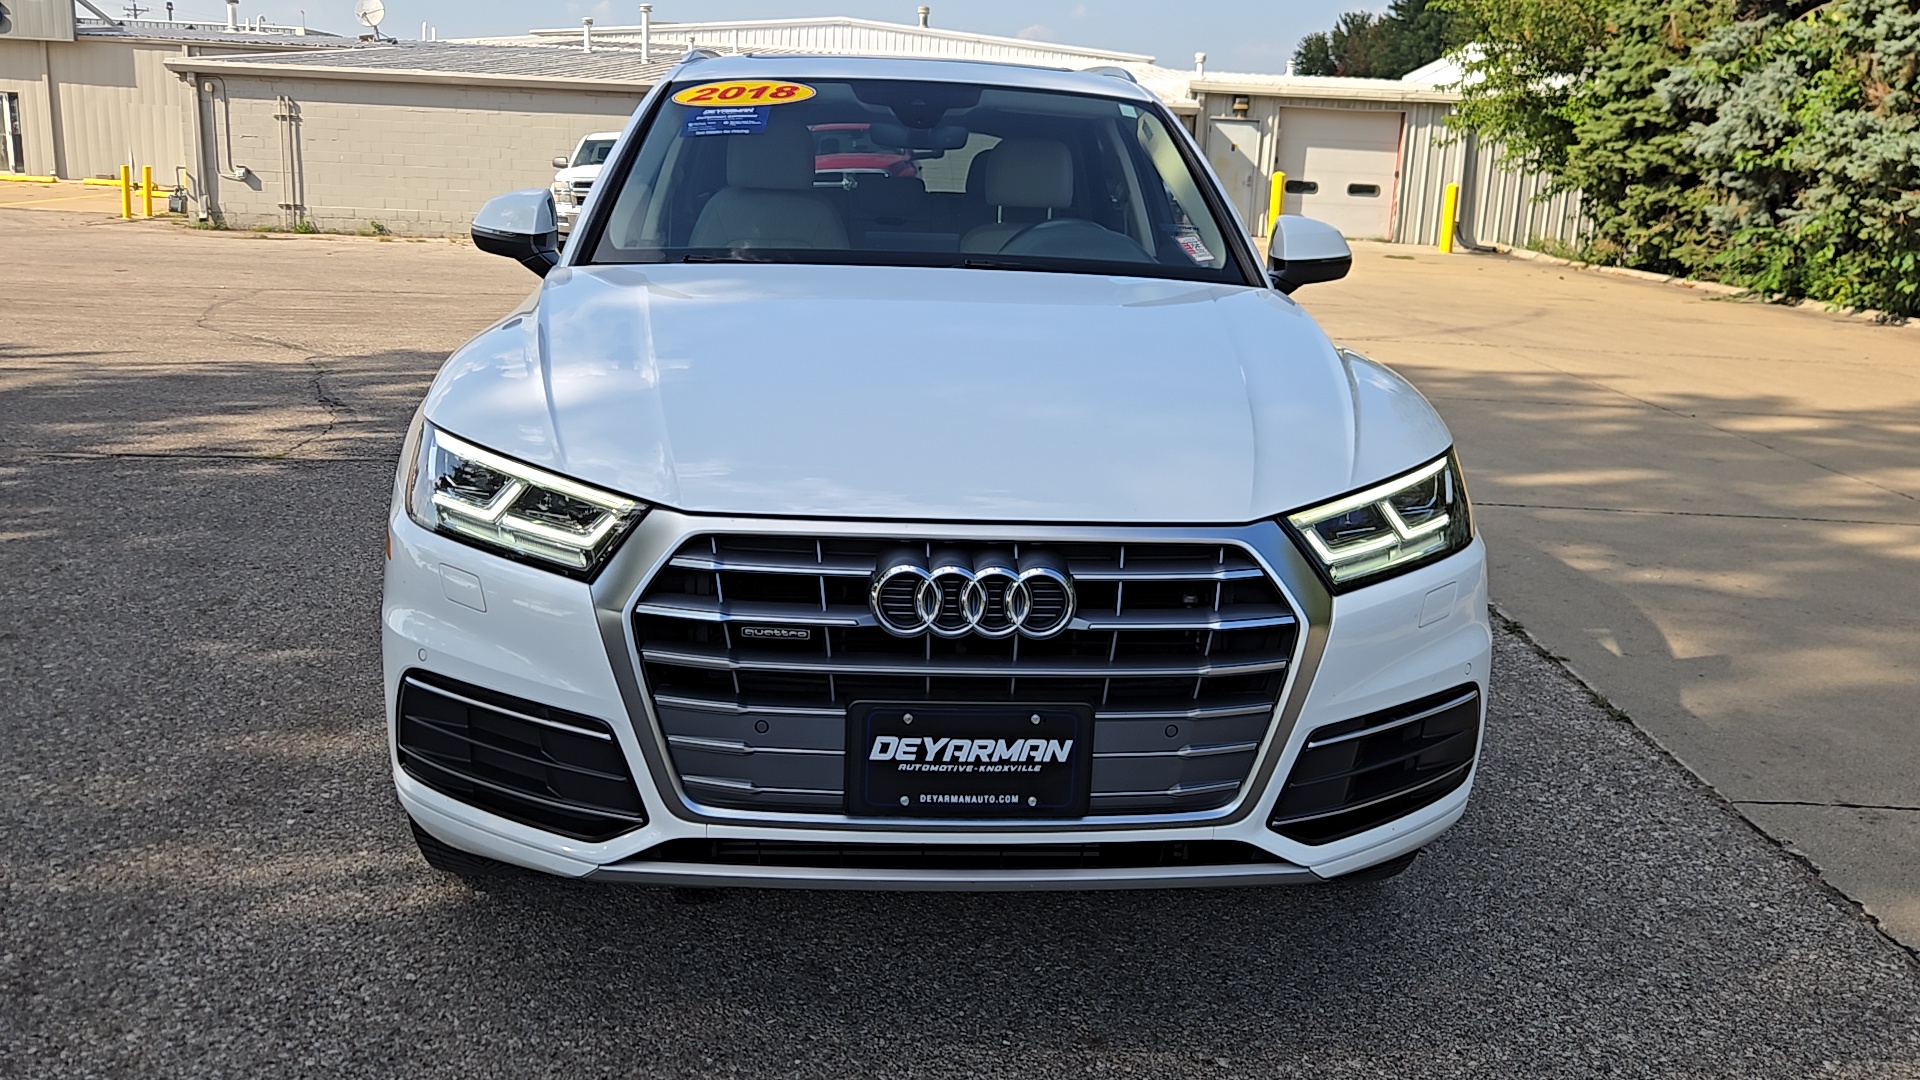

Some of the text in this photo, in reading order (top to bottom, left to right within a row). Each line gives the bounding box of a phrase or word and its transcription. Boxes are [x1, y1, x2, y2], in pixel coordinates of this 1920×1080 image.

[687, 86, 800, 102] 2018
[745, 629, 807, 637] quattro
[869, 736, 1073, 762] DEYARMAN
[919, 794, 1019, 803] DEYARMANAUTO.COM
